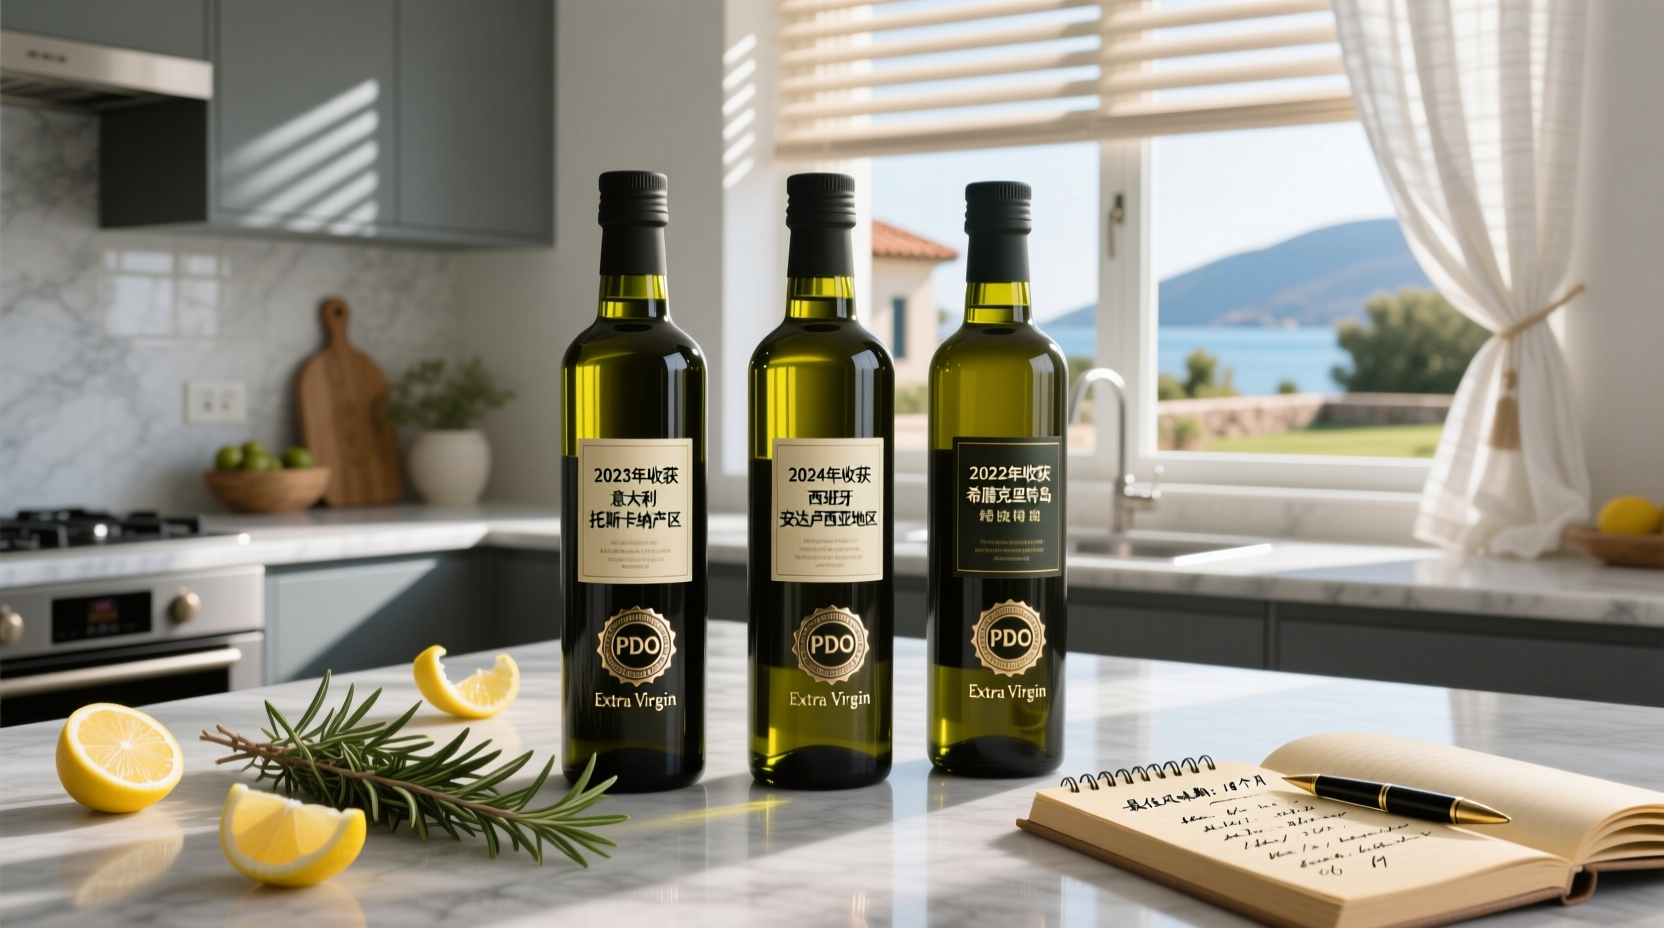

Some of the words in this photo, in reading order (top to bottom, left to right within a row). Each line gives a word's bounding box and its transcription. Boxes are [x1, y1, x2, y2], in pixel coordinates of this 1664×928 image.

[594, 466, 679, 485] 2023年收获
[788, 465, 871, 485] 2024年收获
[616, 635, 660, 655] PDO
[811, 634, 855, 655] PDO
[990, 628, 1032, 648] PDO
[595, 692, 631, 708] Extra
[634, 692, 677, 711] Virgin
[790, 691, 827, 707] Extra
[831, 691, 871, 710] Virgin
[969, 683, 1005, 699] Extra
[1007, 684, 1047, 703] Virgin
